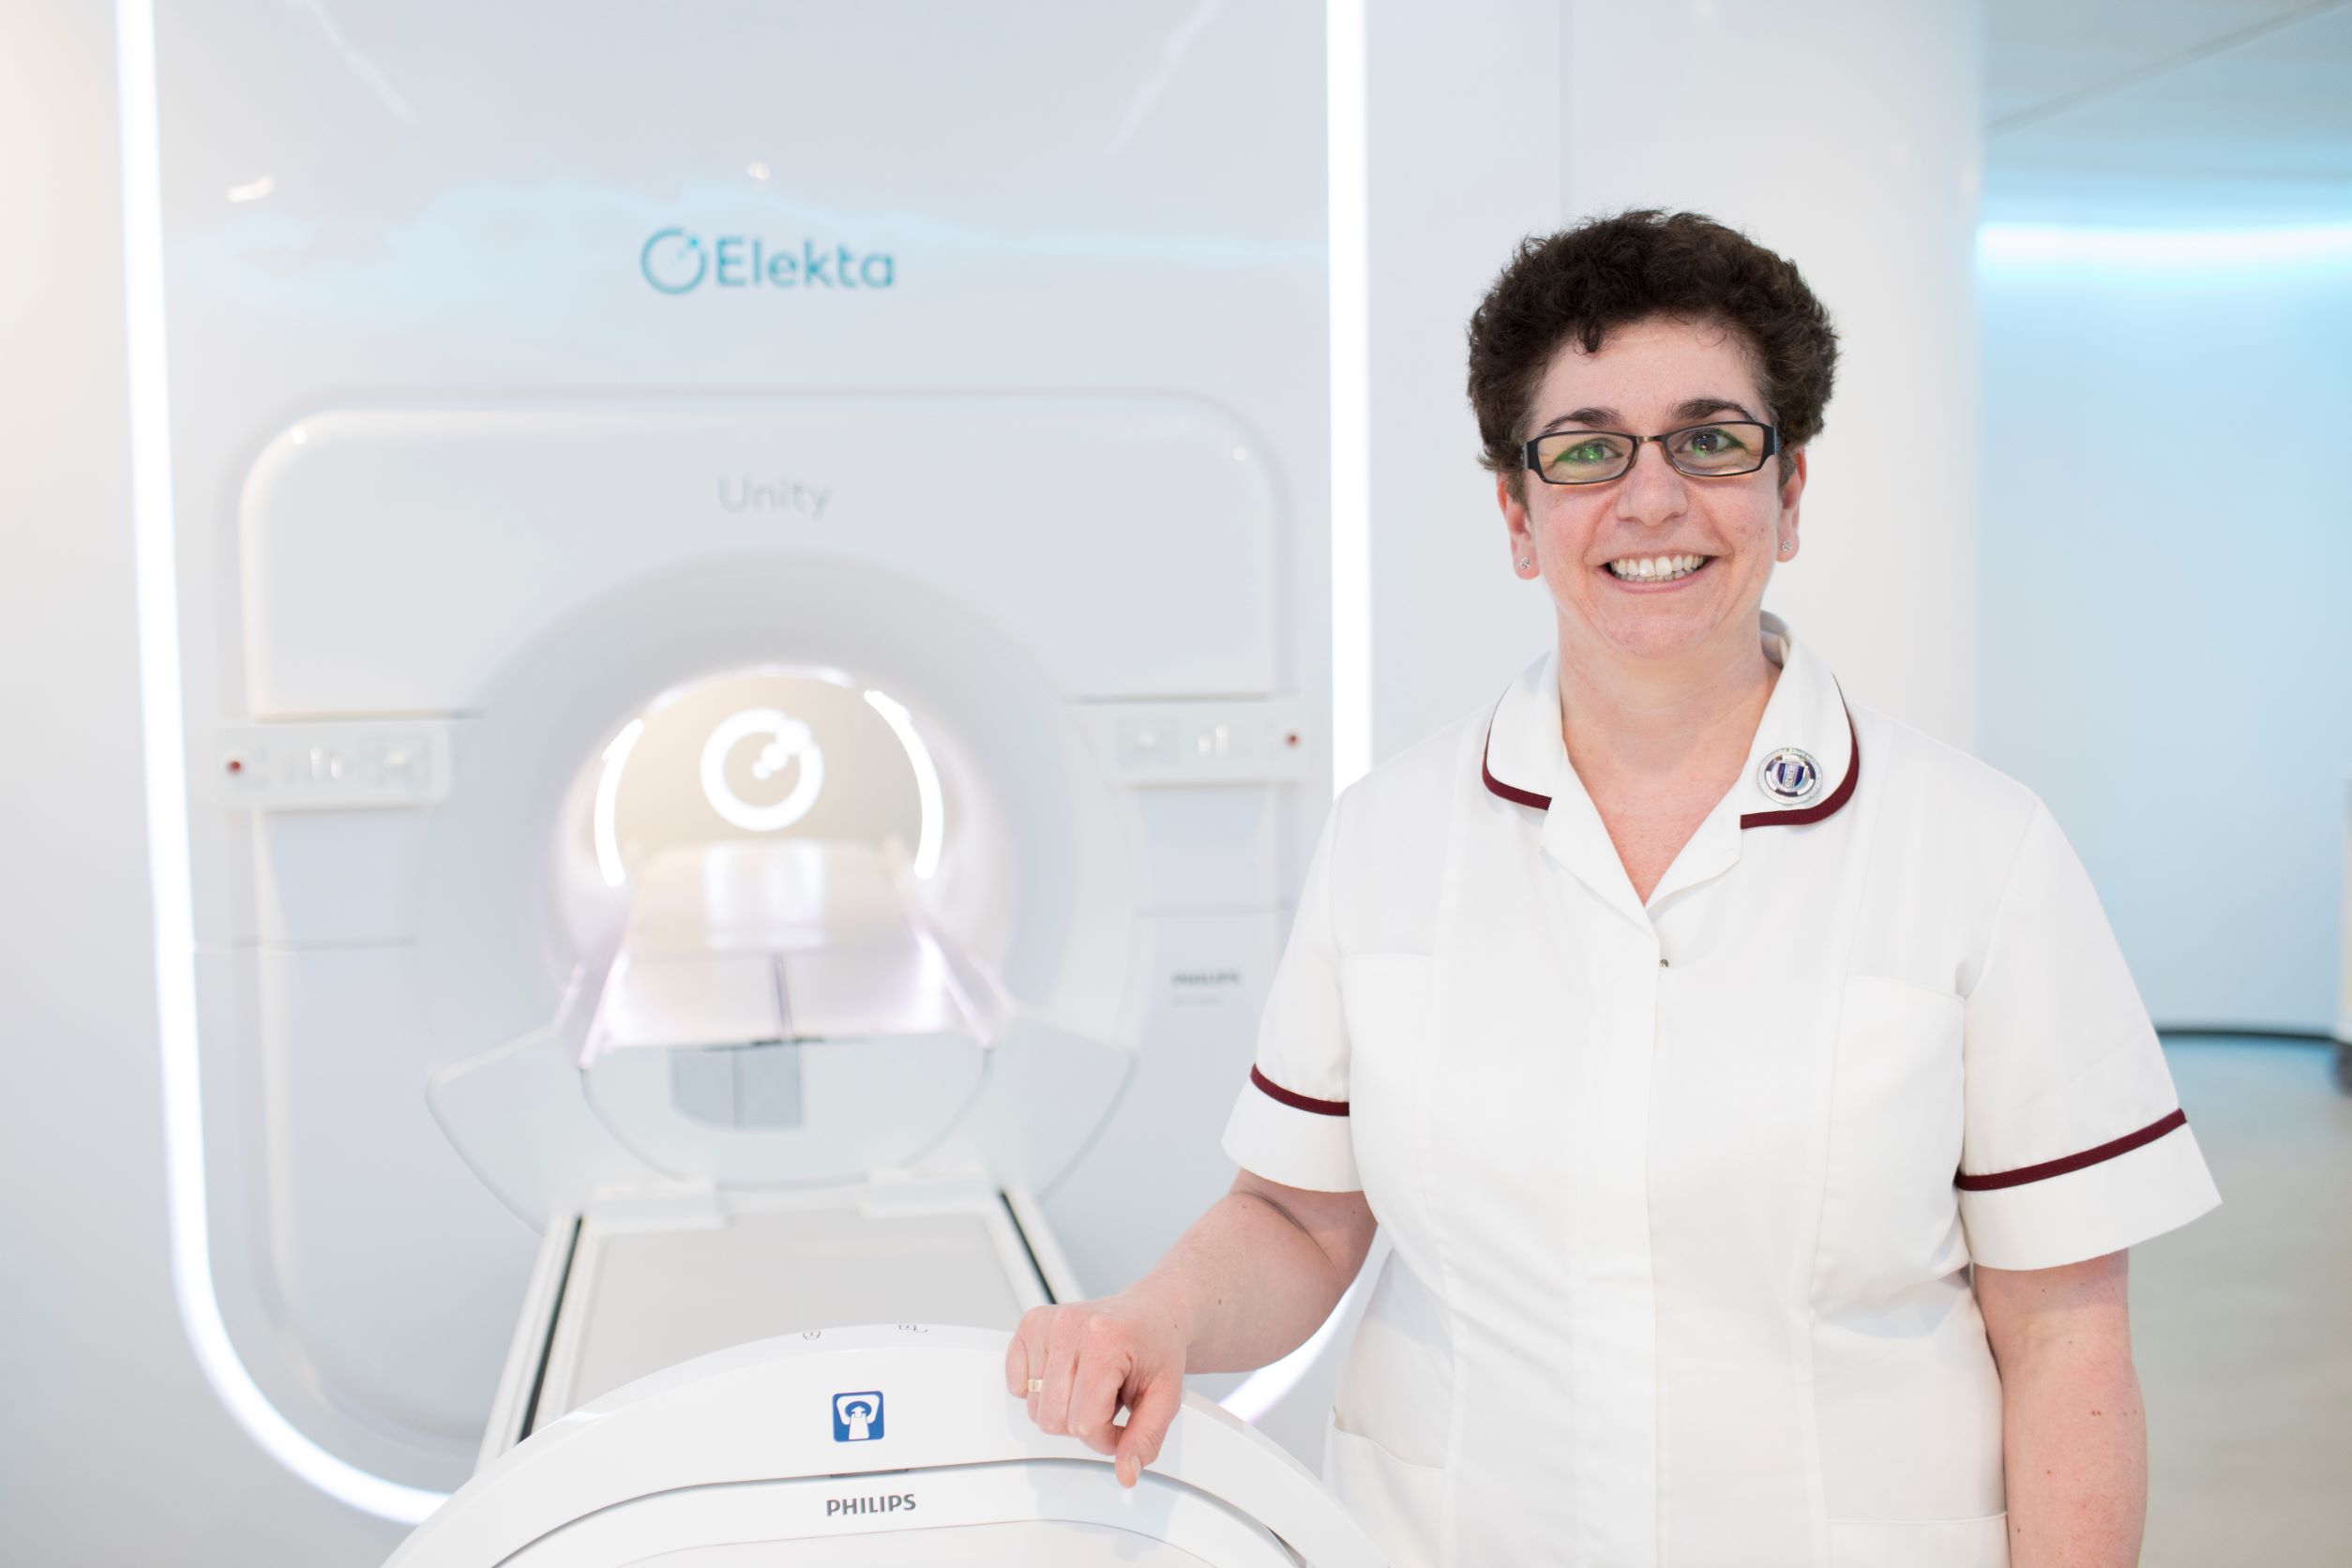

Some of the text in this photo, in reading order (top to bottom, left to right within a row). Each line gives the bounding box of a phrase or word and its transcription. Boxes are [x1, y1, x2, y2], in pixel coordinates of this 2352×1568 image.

[716, 236, 894, 288] Elekta
[717, 473, 832, 521] Unity
[826, 1494, 916, 1516] PHILIPS
